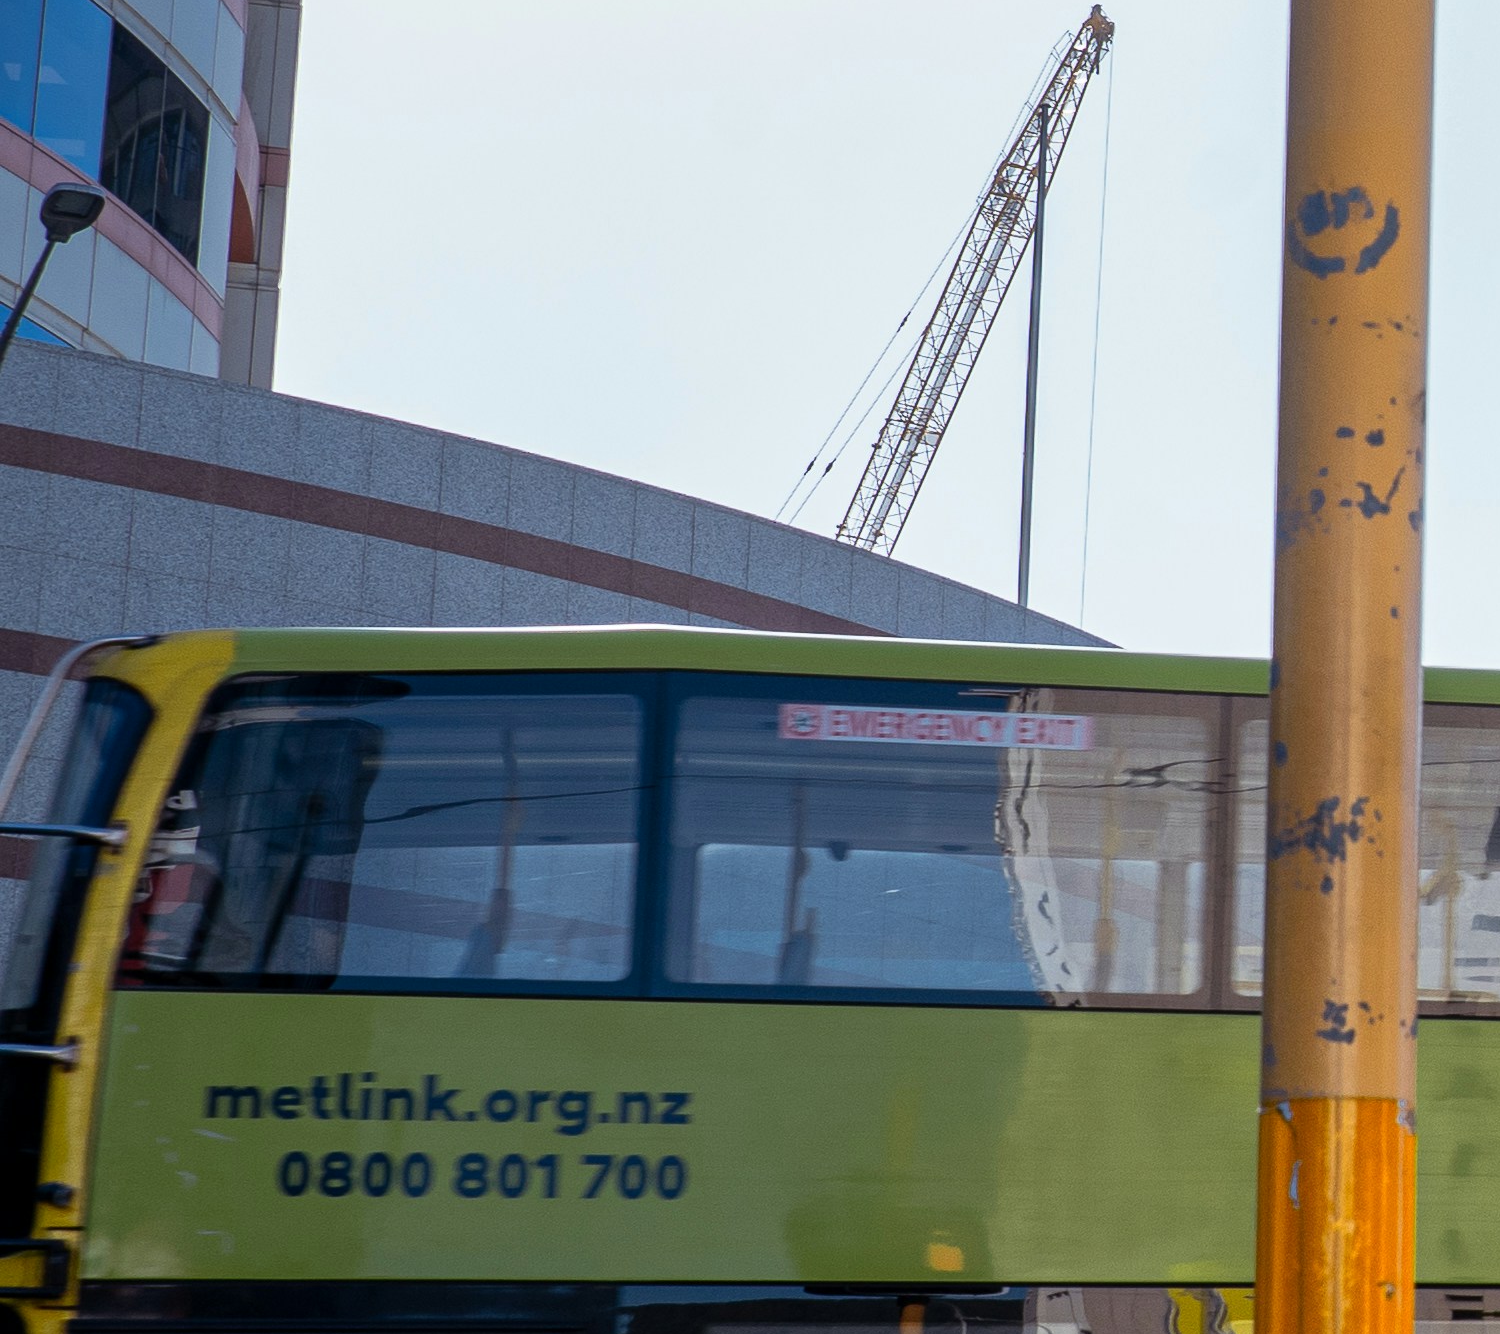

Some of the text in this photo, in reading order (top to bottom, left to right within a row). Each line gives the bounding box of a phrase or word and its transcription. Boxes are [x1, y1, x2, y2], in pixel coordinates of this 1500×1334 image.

[204, 1072, 694, 1136] metlink.org.nz
[276, 1150, 687, 1201] 0800 801 700
